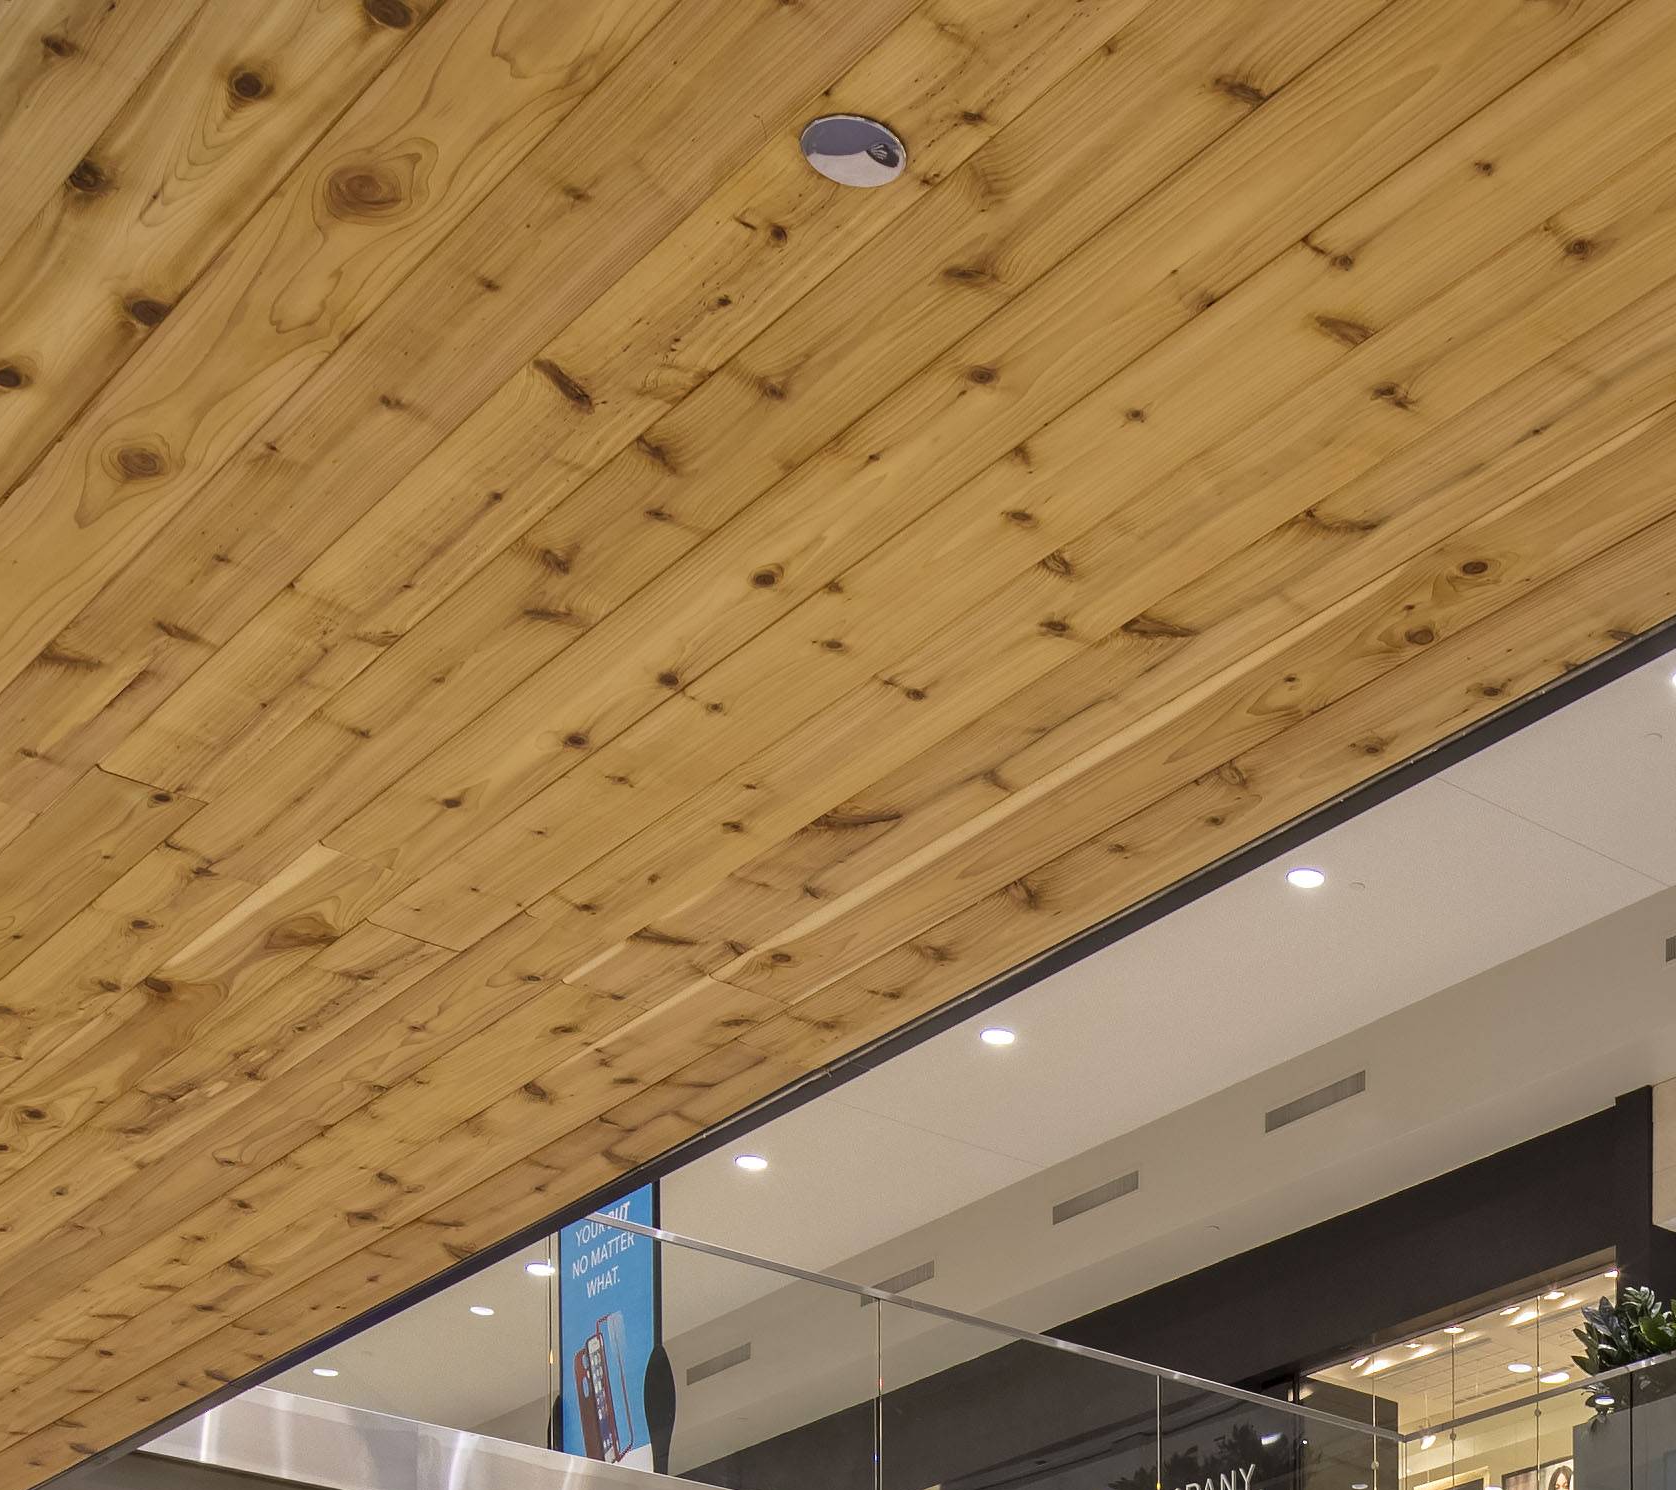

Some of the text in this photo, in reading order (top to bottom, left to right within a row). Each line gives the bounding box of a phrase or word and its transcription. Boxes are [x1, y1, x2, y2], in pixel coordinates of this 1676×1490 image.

[576, 1221, 605, 1247] YOUR
[572, 1231, 635, 1279] NO MATTER
[587, 1265, 620, 1298] WHAT.
